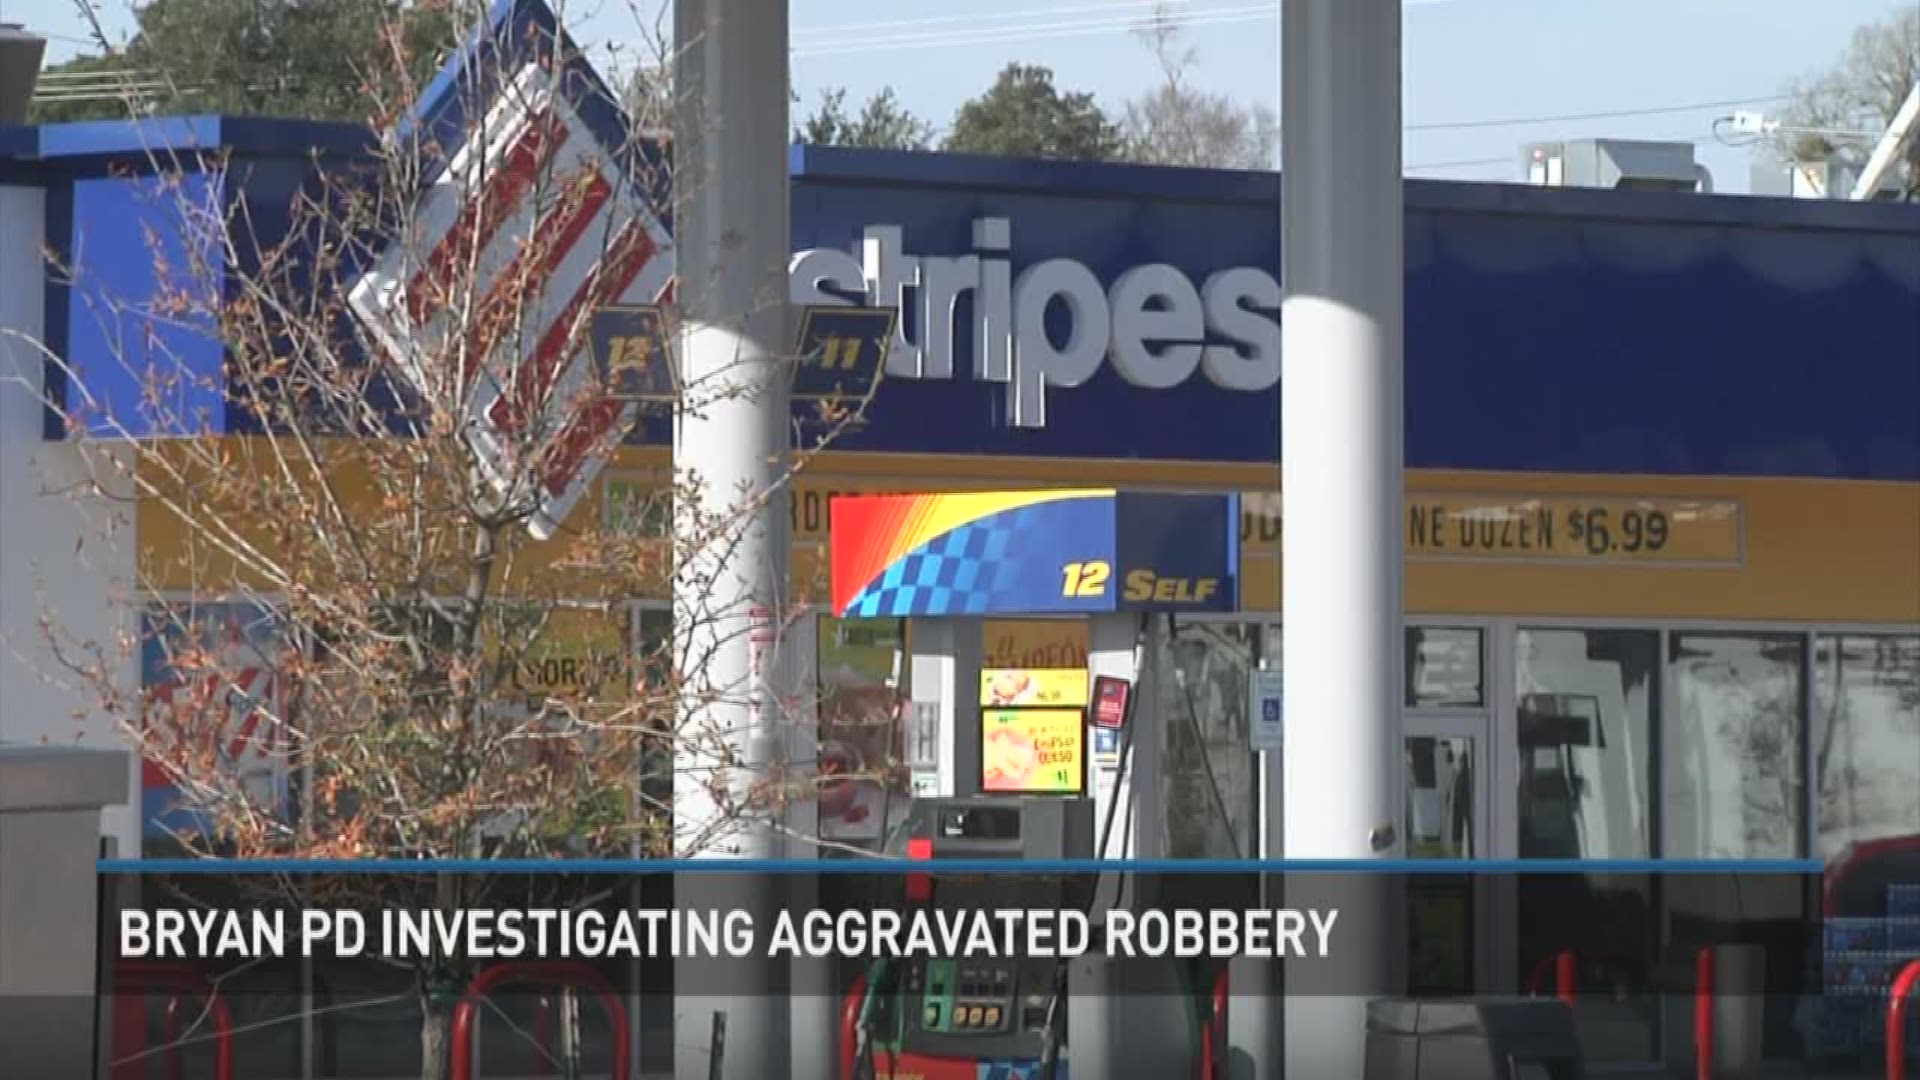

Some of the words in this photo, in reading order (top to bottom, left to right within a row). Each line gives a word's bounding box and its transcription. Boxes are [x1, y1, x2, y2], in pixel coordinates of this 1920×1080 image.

[819, 336, 864, 370] 11
[1458, 507, 1554, 550] DOZEN
[1567, 507, 1669, 555] $6.99
[1061, 559, 1111, 598] 12
